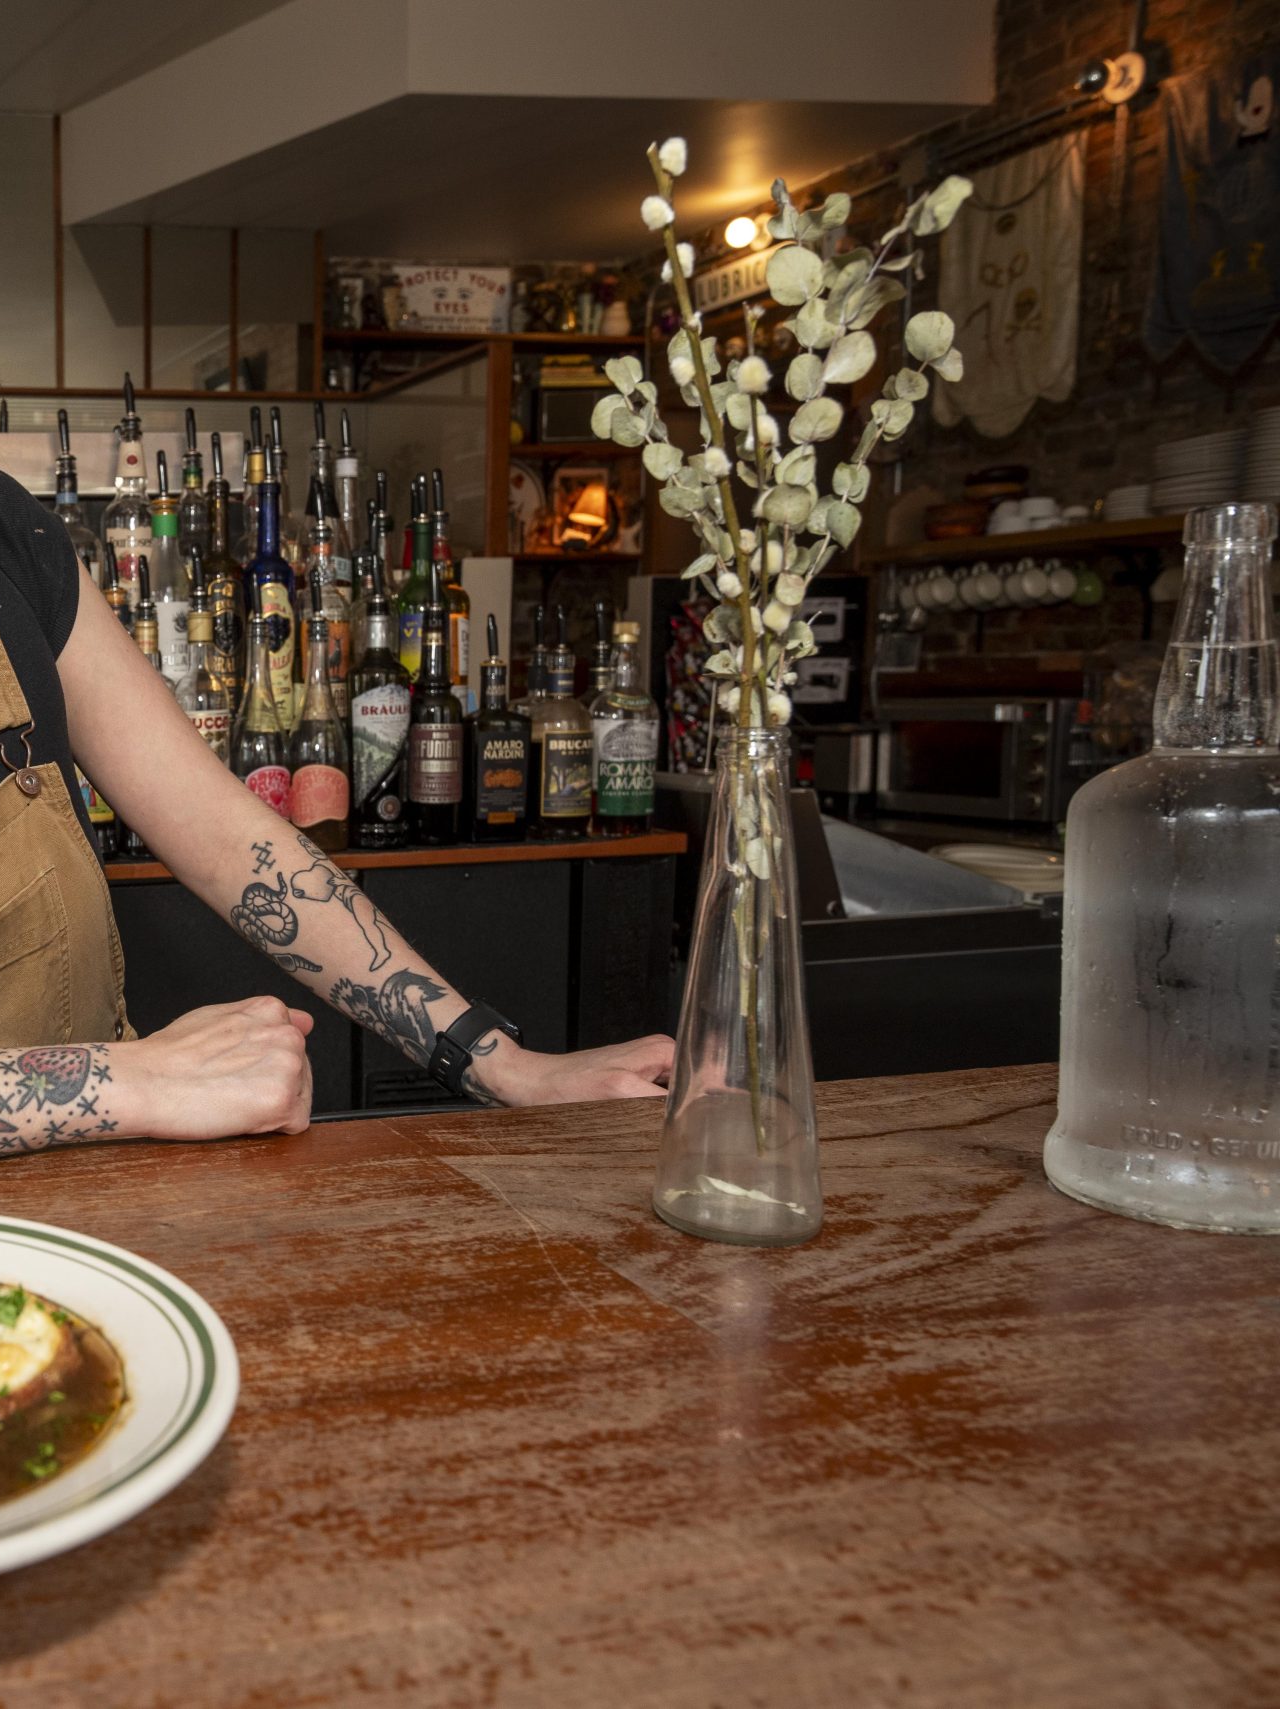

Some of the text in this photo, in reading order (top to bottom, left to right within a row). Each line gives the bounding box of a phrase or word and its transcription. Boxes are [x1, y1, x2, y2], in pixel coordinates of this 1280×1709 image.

[469, 272, 506, 295] YOUR
[696, 260, 764, 308] LUBRIC
[434, 302, 469, 314] EYES
[485, 739, 525, 750] AMARO
[483, 749, 525, 760] NARDINI
[605, 776, 654, 790] AMARO
